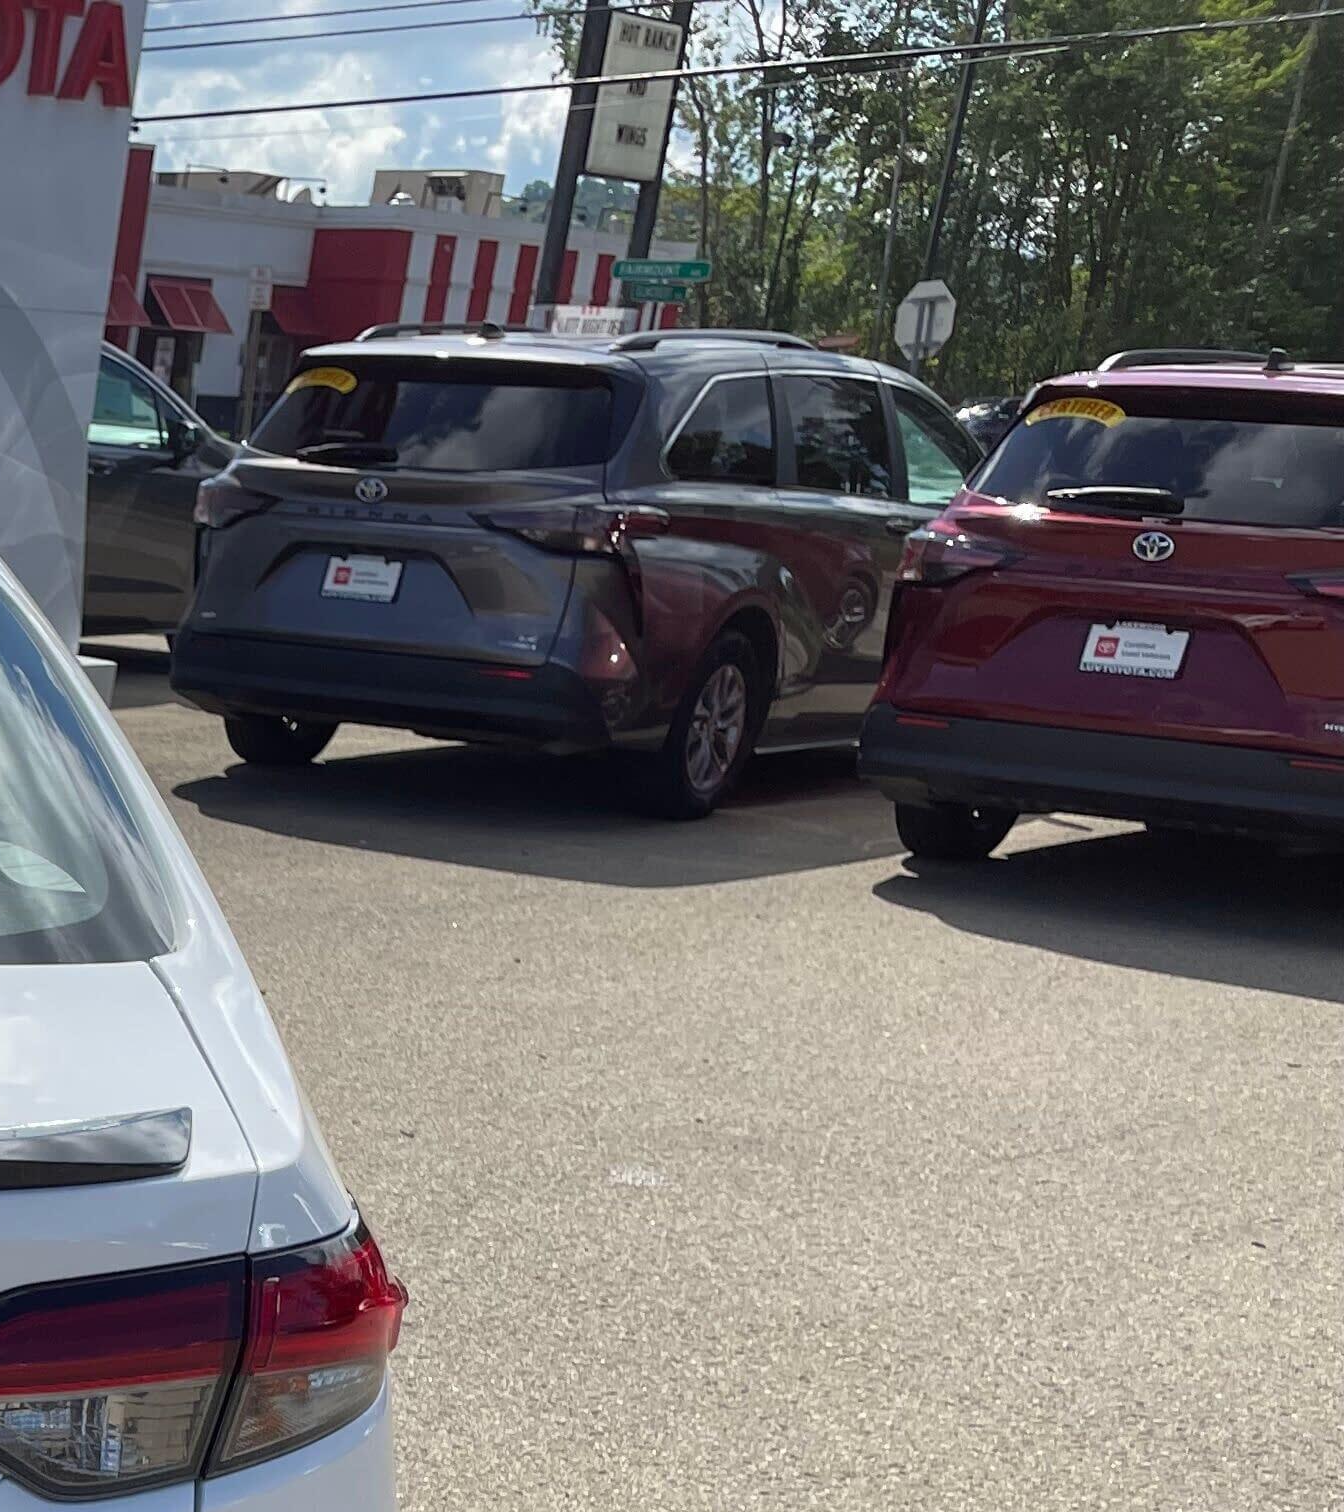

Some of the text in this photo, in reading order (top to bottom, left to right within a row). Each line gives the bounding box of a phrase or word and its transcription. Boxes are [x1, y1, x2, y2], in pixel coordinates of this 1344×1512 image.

[619, 21, 677, 50] HOT RANCH
[615, 123, 648, 147] WINGS
